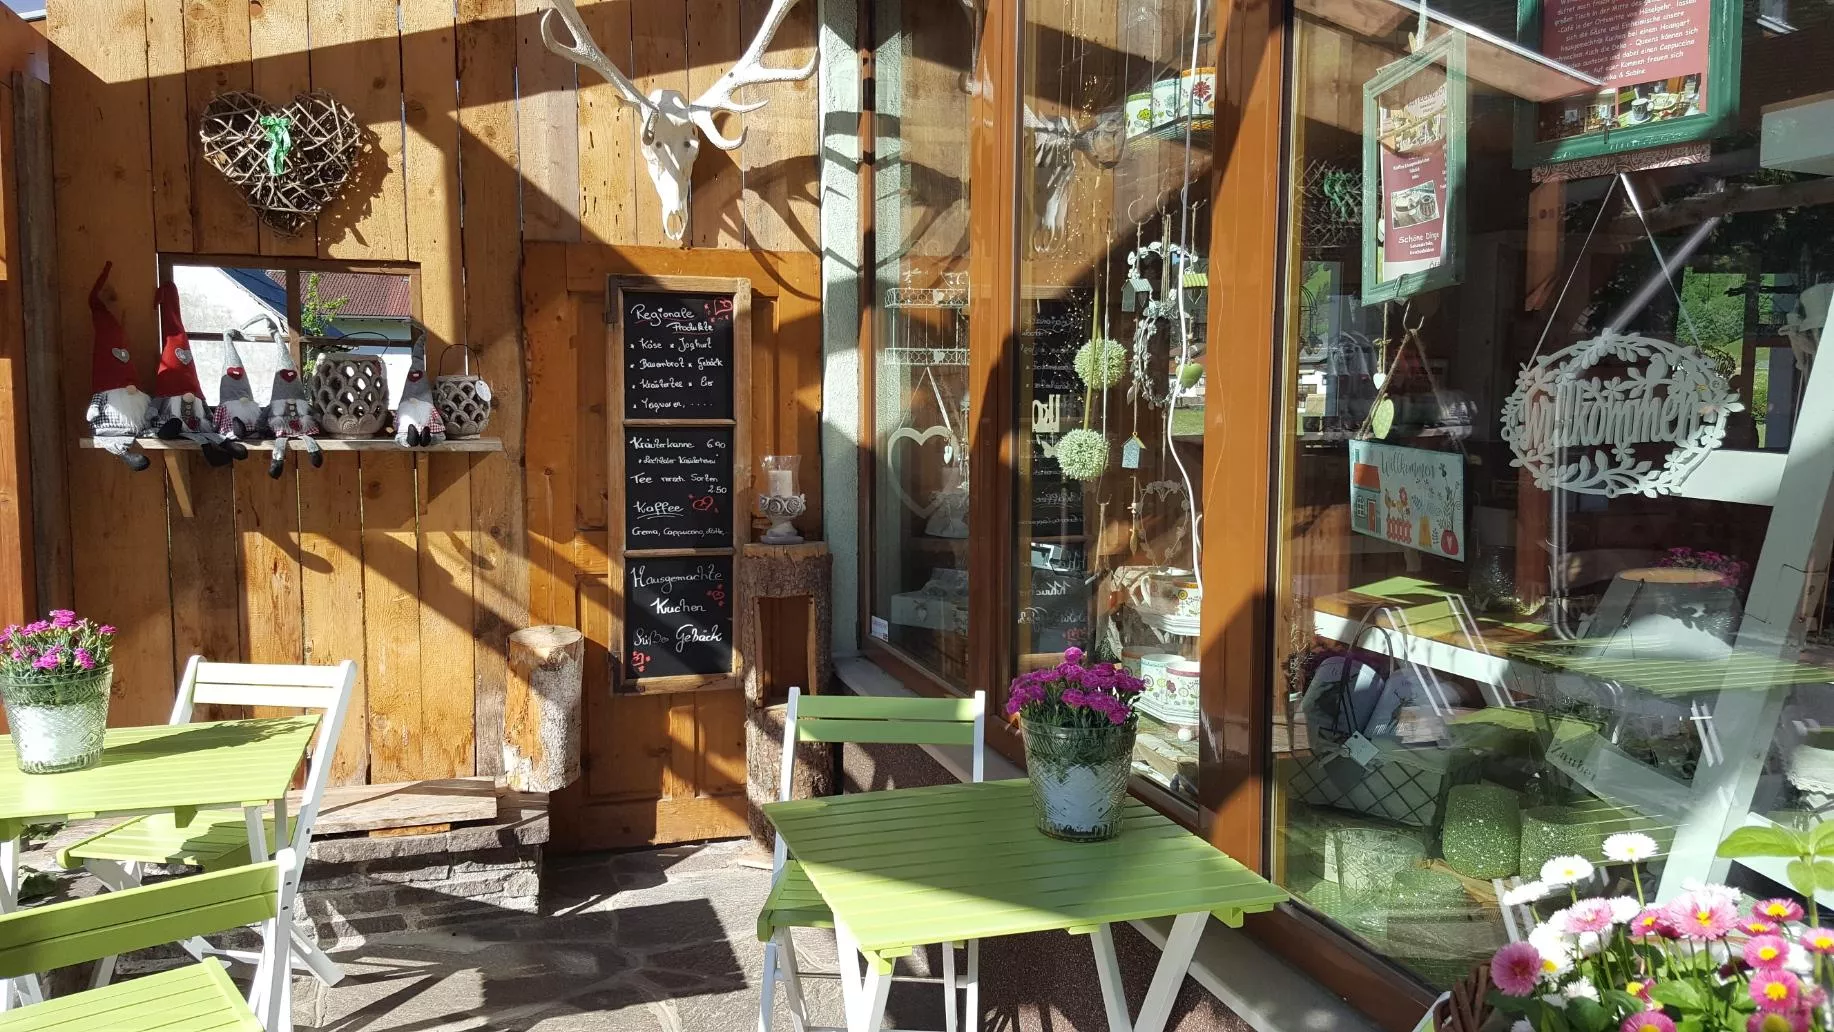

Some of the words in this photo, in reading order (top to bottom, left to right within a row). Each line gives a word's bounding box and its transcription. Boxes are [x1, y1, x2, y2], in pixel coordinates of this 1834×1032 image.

[1670, 49, 1683, 58] sich
[630, 303, 695, 327] Regionale
[665, 321, 714, 333] Produkte
[639, 337, 662, 350] Käse
[678, 336, 712, 352] Joghurt
[1524, 381, 1701, 450] Willkommen
[629, 471, 653, 484] Tee
[632, 500, 685, 516] Kaffee
[630, 563, 723, 594] Hausgemachte
[649, 597, 707, 615] Kuchen
[675, 623, 723, 653] Gebäck
